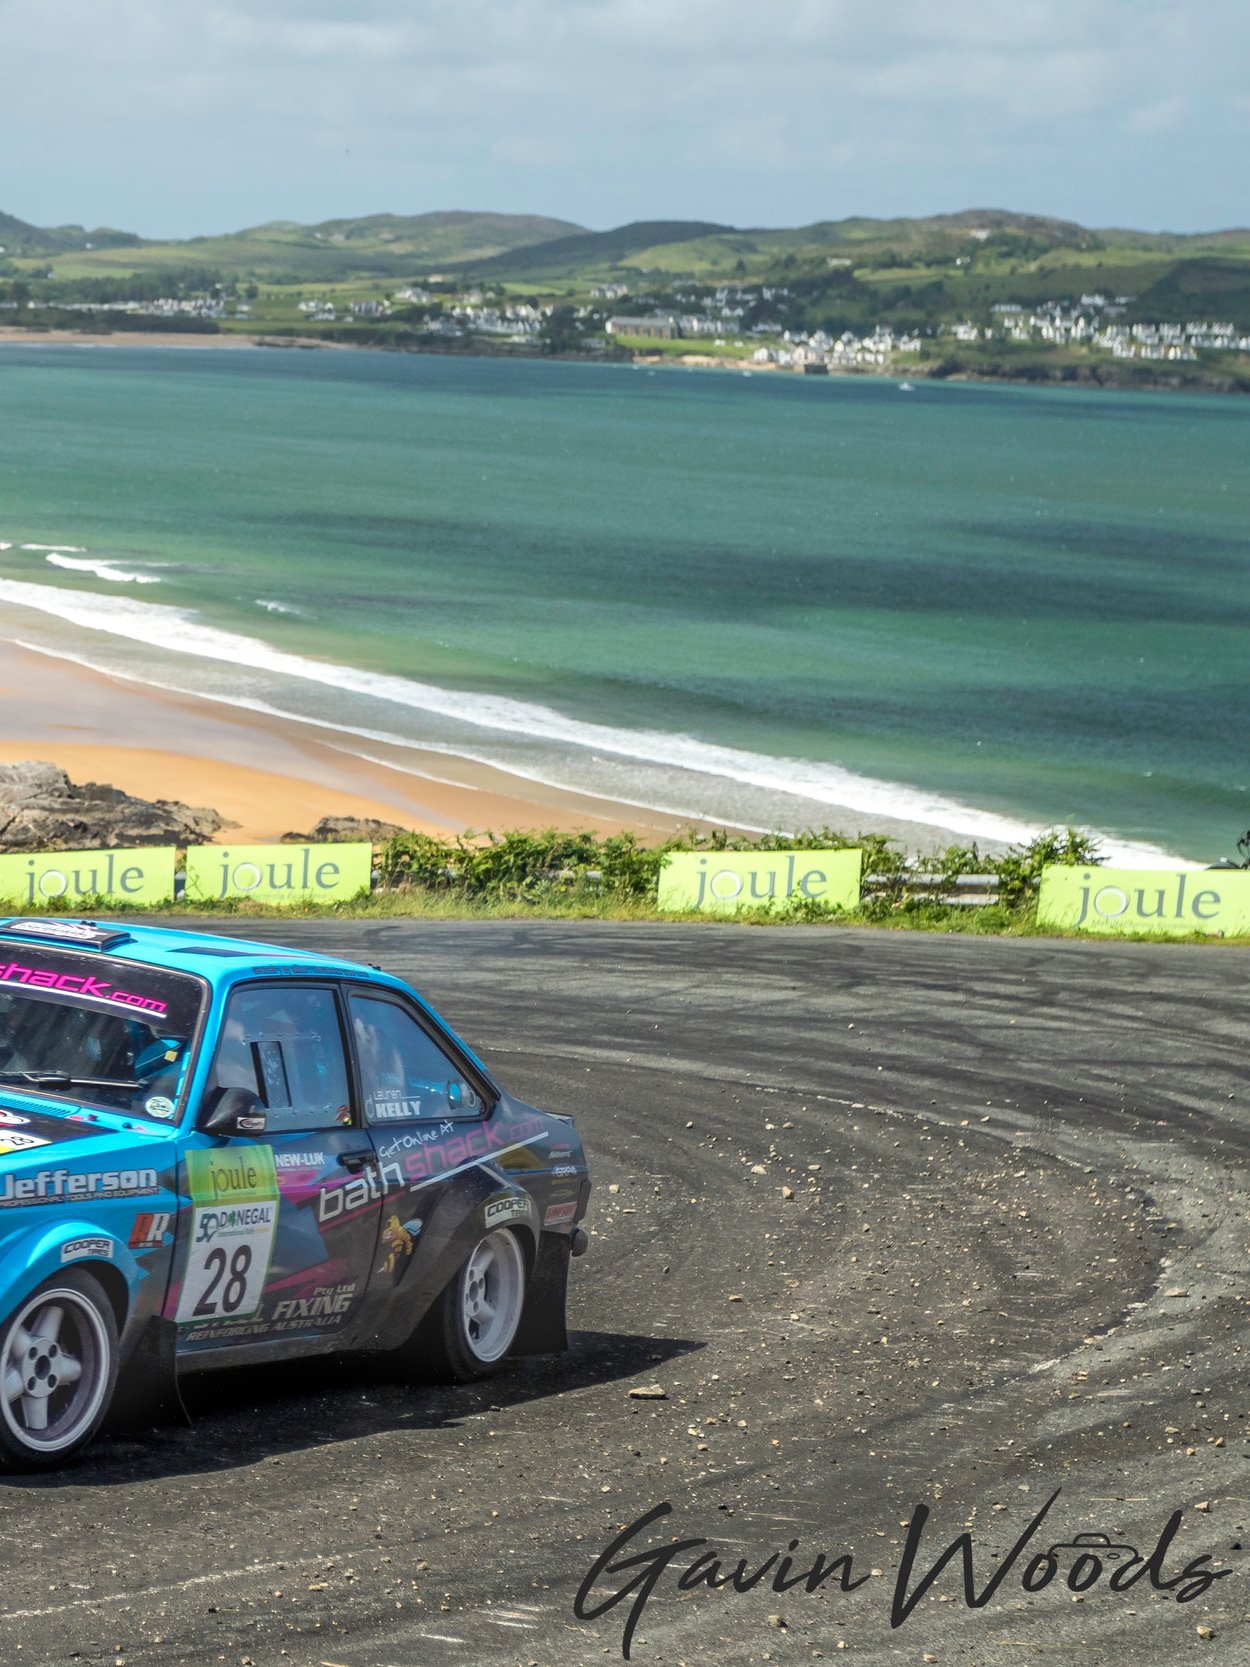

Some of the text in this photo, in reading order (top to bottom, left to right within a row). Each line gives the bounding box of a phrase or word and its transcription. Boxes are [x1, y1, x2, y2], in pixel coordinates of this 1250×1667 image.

[25, 854, 145, 900] joule
[219, 848, 340, 899] joule
[692, 855, 827, 912] joule
[1074, 873, 1221, 928] joule
[375, 1100, 421, 1118] KELLY
[0, 1135, 35, 1146] 28
[275, 1151, 326, 1168] NEW-LUK
[210, 1156, 257, 1201] joule
[487, 1199, 529, 1217] COOPER
[63, 1239, 111, 1254] COOPER
[191, 1244, 253, 1317] 28
[337, 1283, 355, 1293] Ltd
[272, 1294, 354, 1321] FIXING
[186, 1322, 269, 1342] REINFORCING
[271, 1315, 342, 1332] AUSTRALIA
